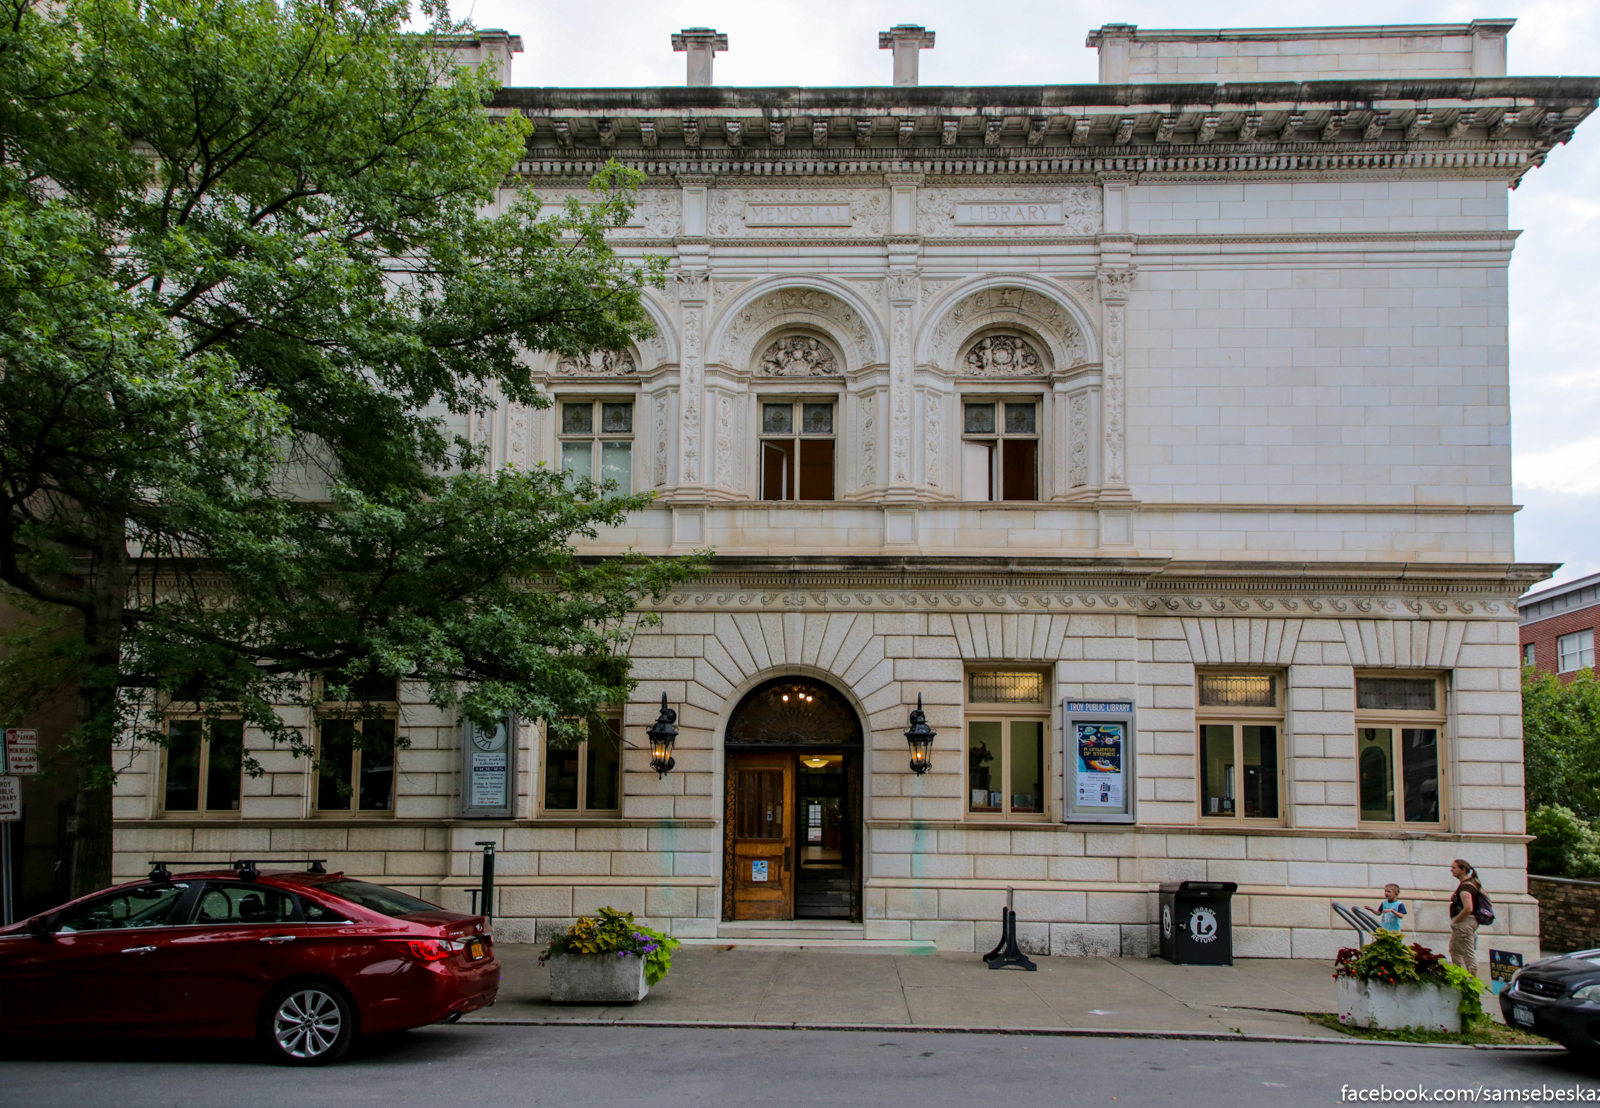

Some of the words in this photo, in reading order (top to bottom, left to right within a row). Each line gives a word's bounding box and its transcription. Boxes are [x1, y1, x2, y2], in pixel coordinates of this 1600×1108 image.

[752, 207, 846, 222] MEMORIAL
[969, 206, 1050, 221] LIBRARY
[1070, 703, 1084, 711] TROY
[1086, 703, 1106, 711] PUBLIC
[1106, 704, 1130, 712] LIBRARY
[8, 732, 16, 741] NO
[1190, 907, 1216, 916] LIBRARY
[1190, 933, 1217, 944] RETURN
